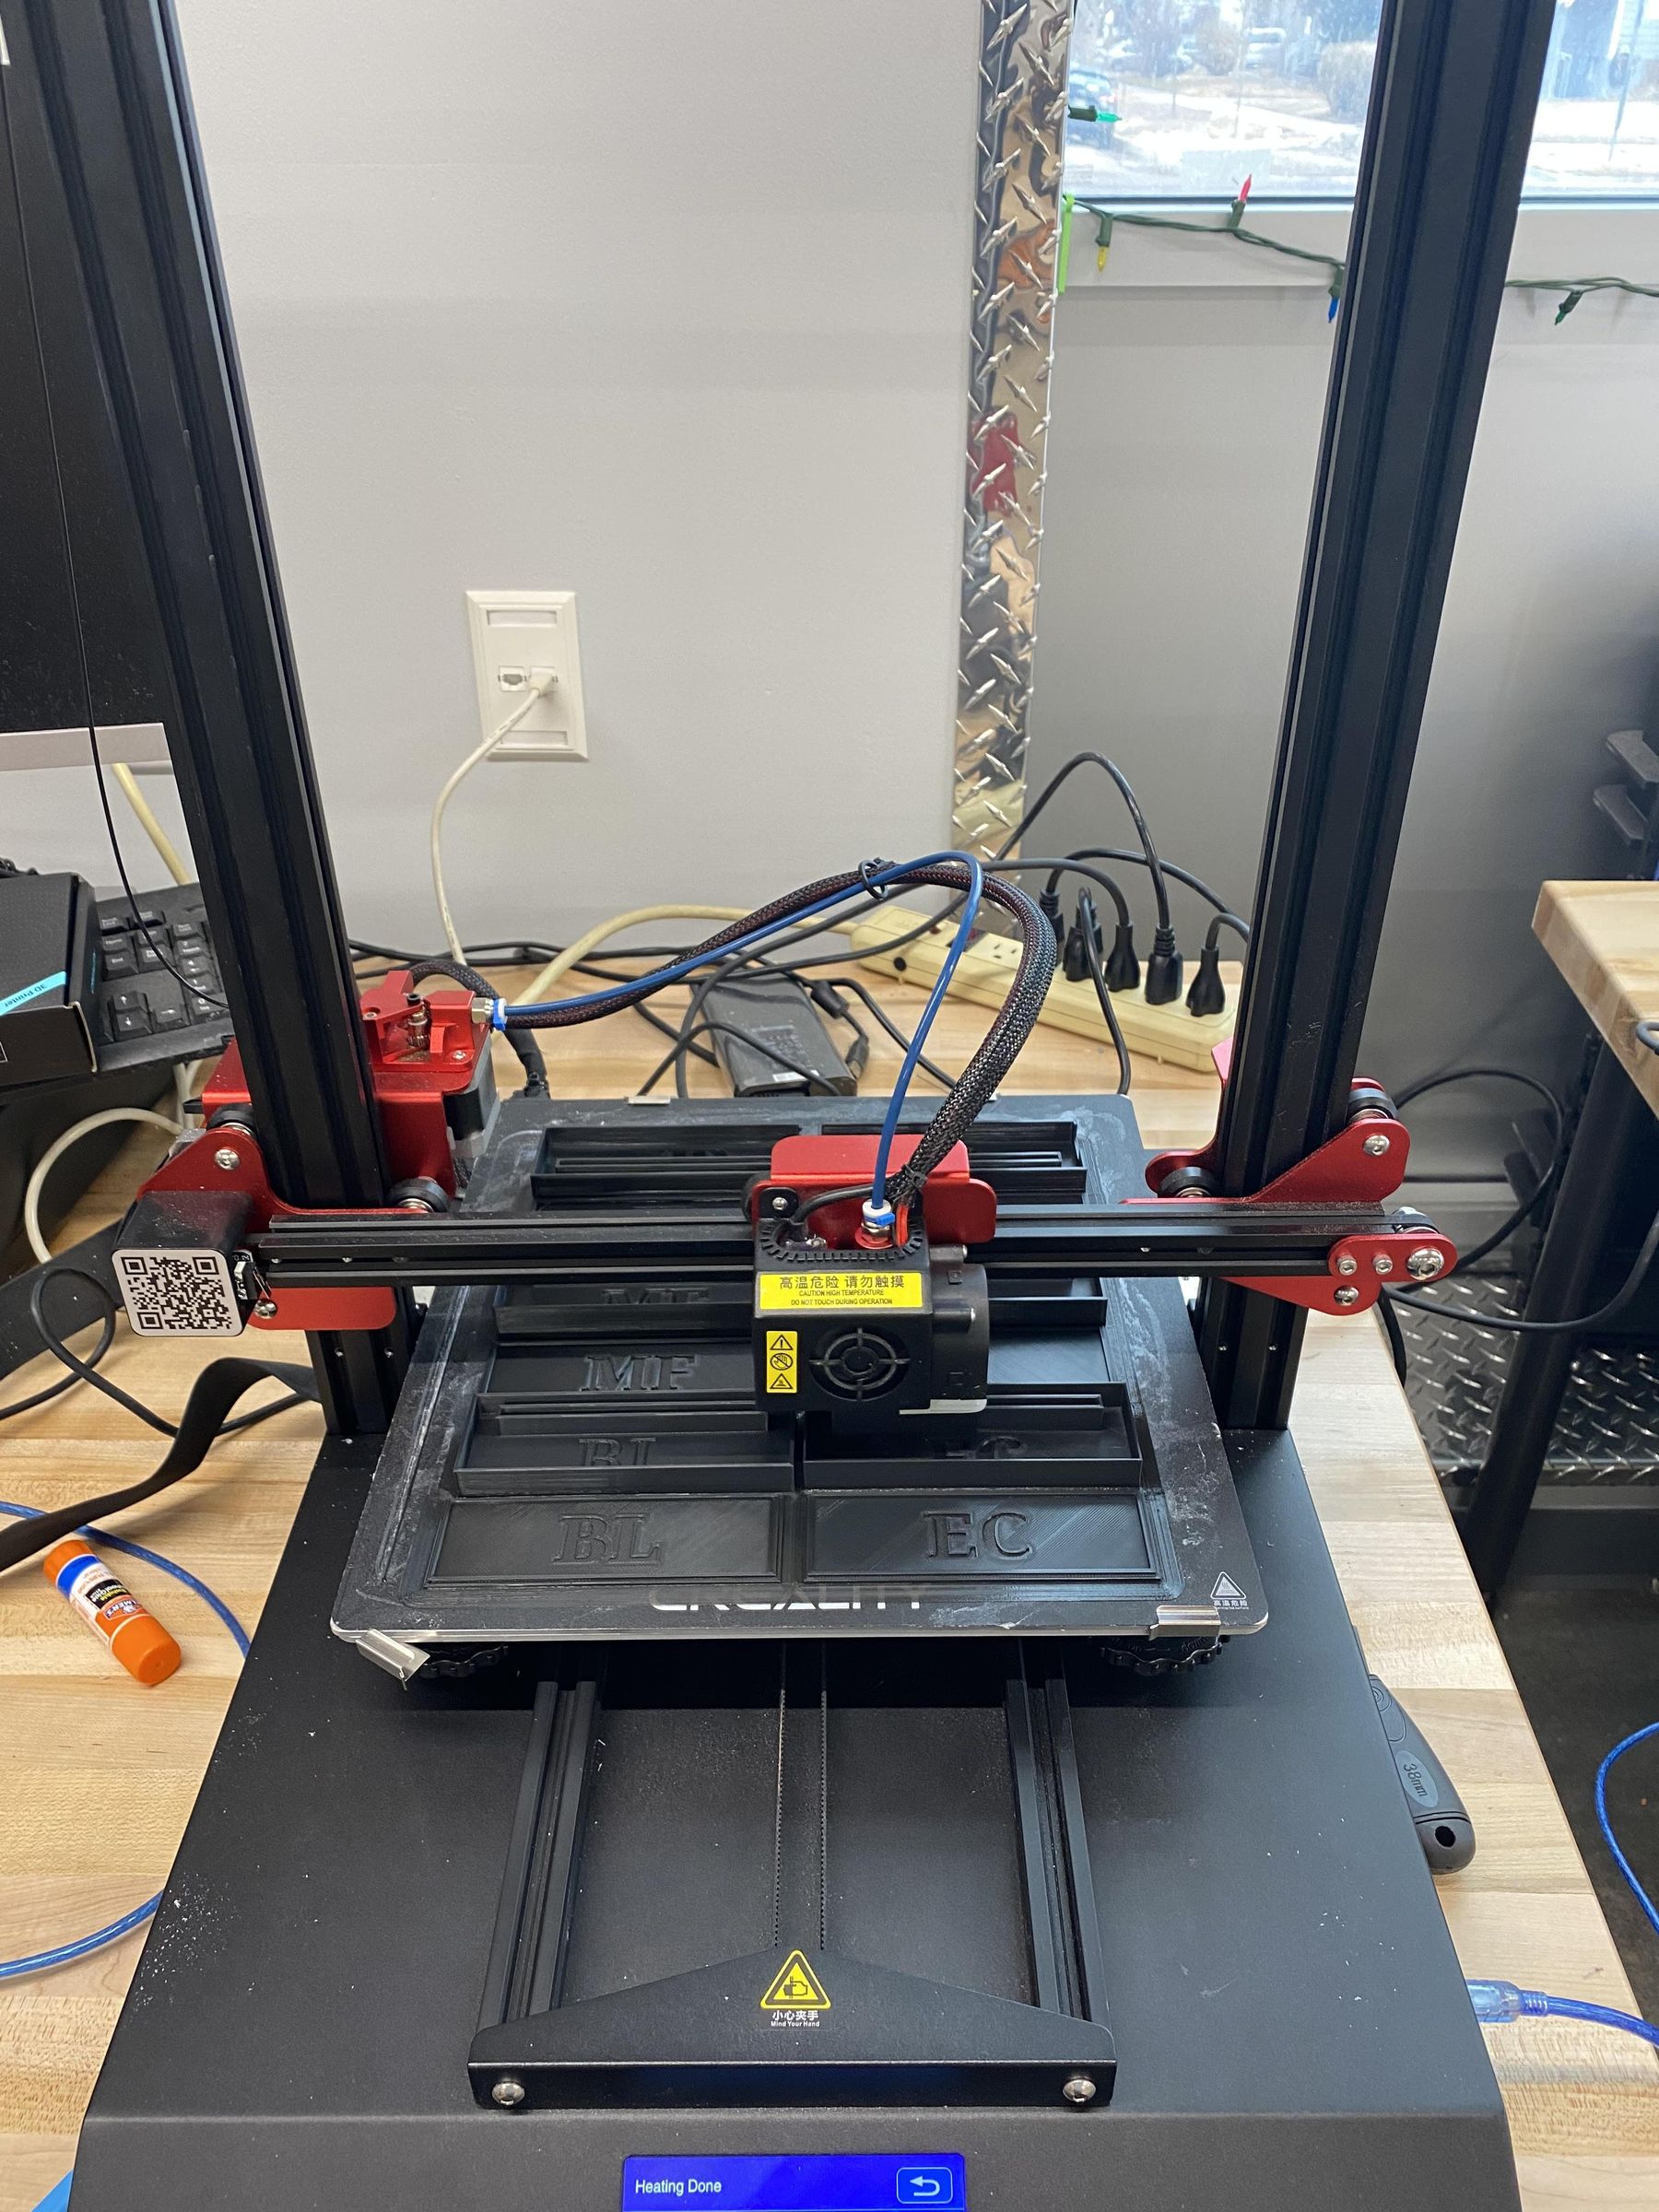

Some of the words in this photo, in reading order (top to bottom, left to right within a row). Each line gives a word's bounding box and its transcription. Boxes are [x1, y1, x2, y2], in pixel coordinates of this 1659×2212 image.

[5, 990, 34, 1007] Printer
[780, 1276, 840, 1289] 高温危险
[845, 1275, 904, 1288] 请勿触摸
[552, 1512, 662, 1564] BL
[922, 1511, 1033, 1560] EC
[1404, 1762, 1429, 1797] 38mm
[771, 2010, 819, 2021] 小心夹手
[634, 2179, 685, 2197] Heating
[687, 2179, 723, 2194] Done
